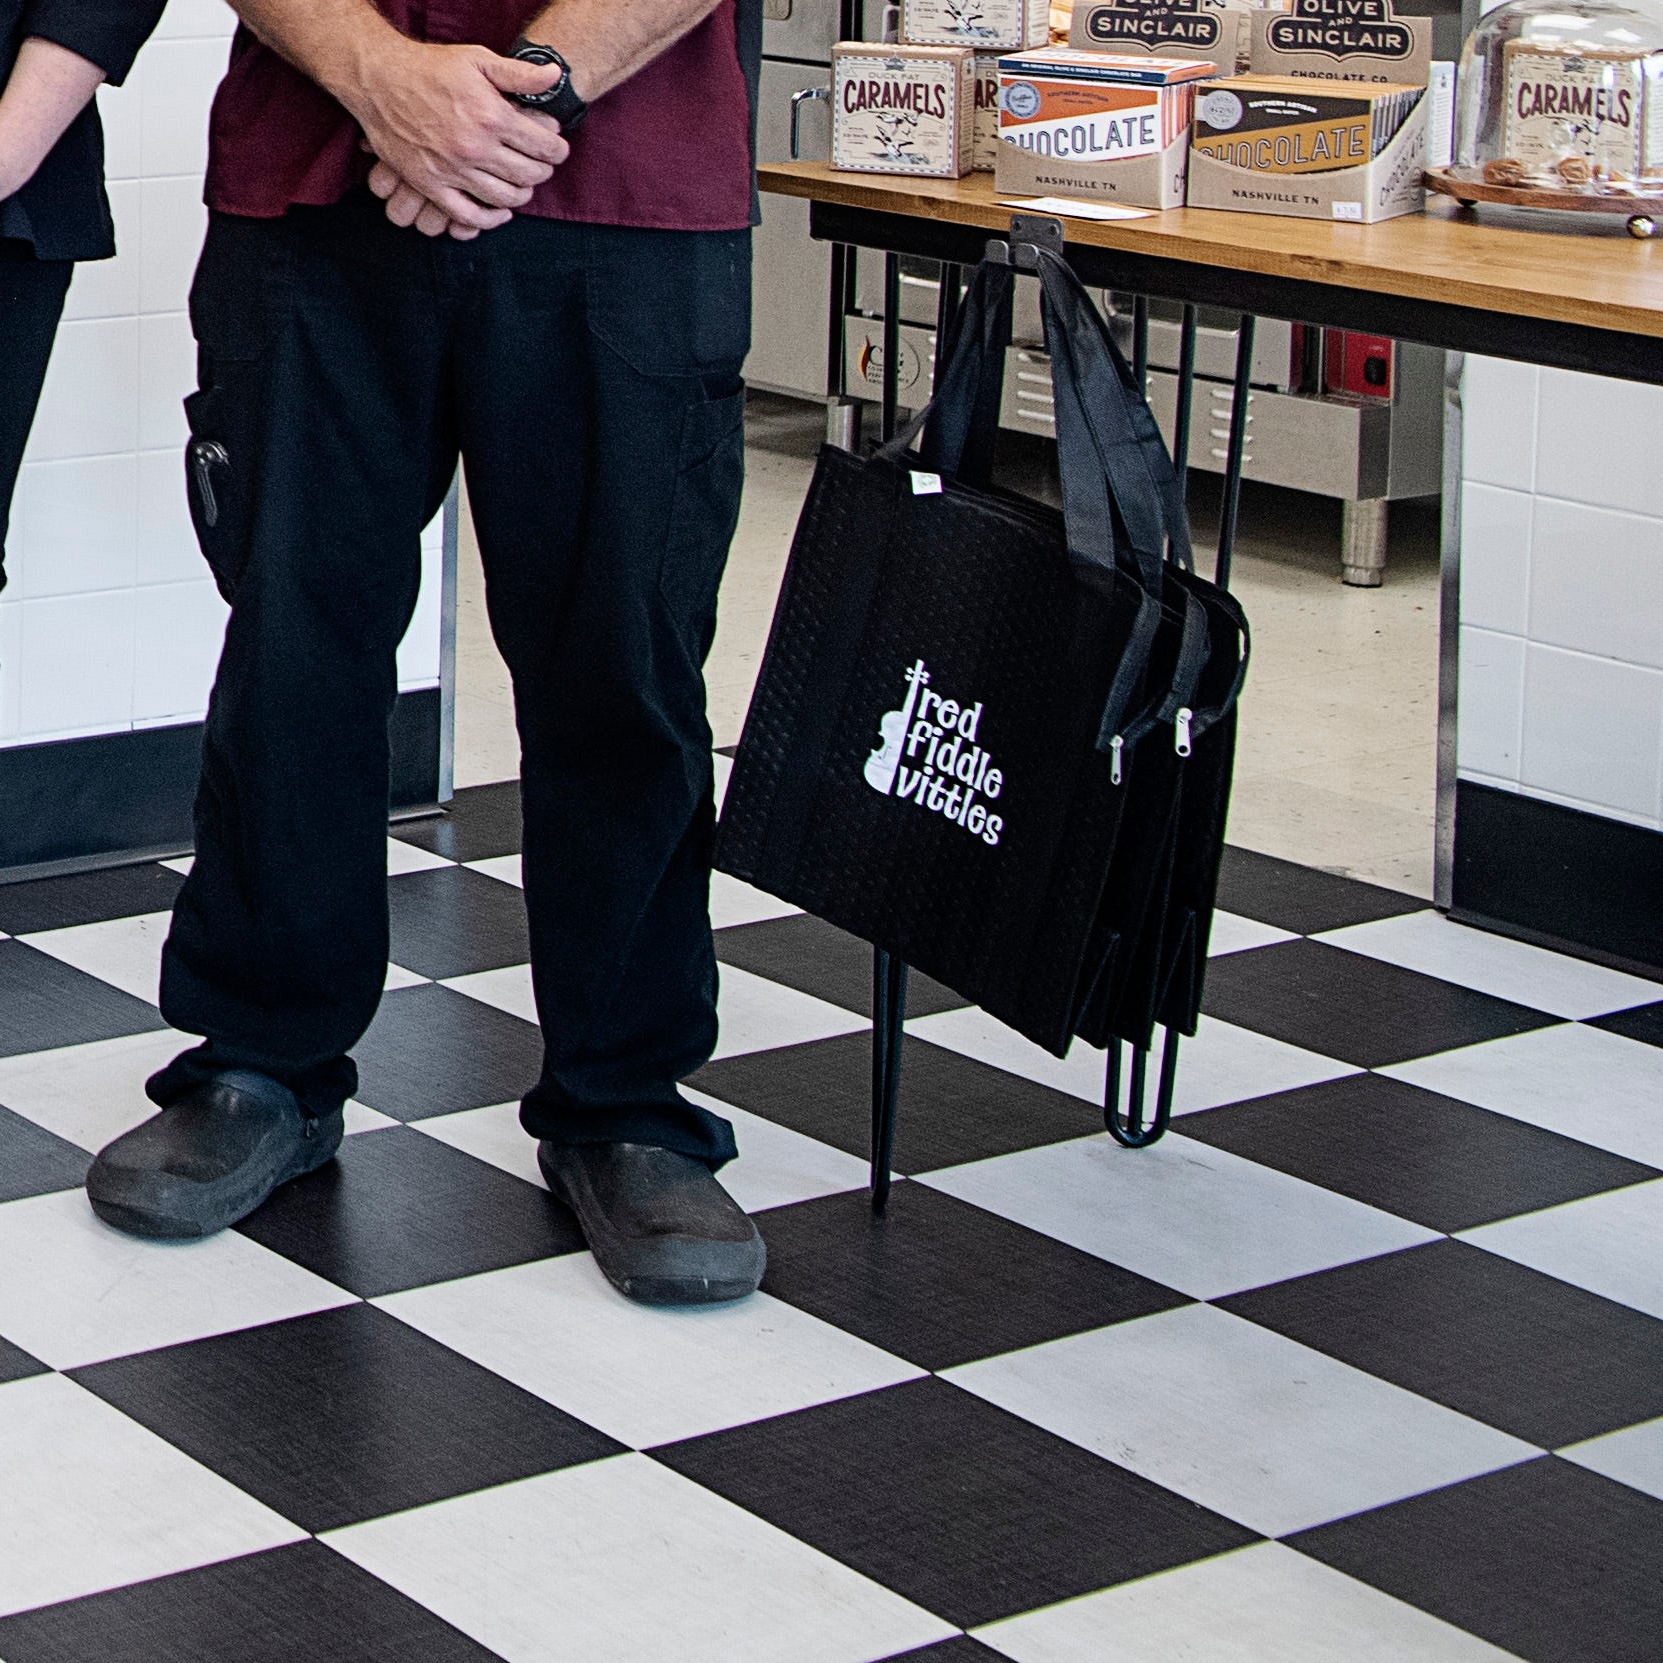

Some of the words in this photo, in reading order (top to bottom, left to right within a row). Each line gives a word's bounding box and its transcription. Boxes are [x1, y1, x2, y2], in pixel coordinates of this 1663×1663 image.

[1143, 7, 1169, 18] AND
[1327, 16, 1353, 27] AND
[1097, 16, 1212, 38] SINCLAIR
[1278, 28, 1402, 49] SINCLAIR
[843, 78, 947, 120] CARAMELS
[1517, 82, 1631, 128] CARAMELS
[1035, 175, 1099, 190] NASHVILLE
[1102, 182, 1117, 191] TN
[1232, 189, 1300, 204] NASHVILLE
[1303, 196, 1319, 205] TN
[919, 686, 983, 744] red
[908, 722, 1004, 798] fiddle
[895, 764, 1004, 846] vittles
